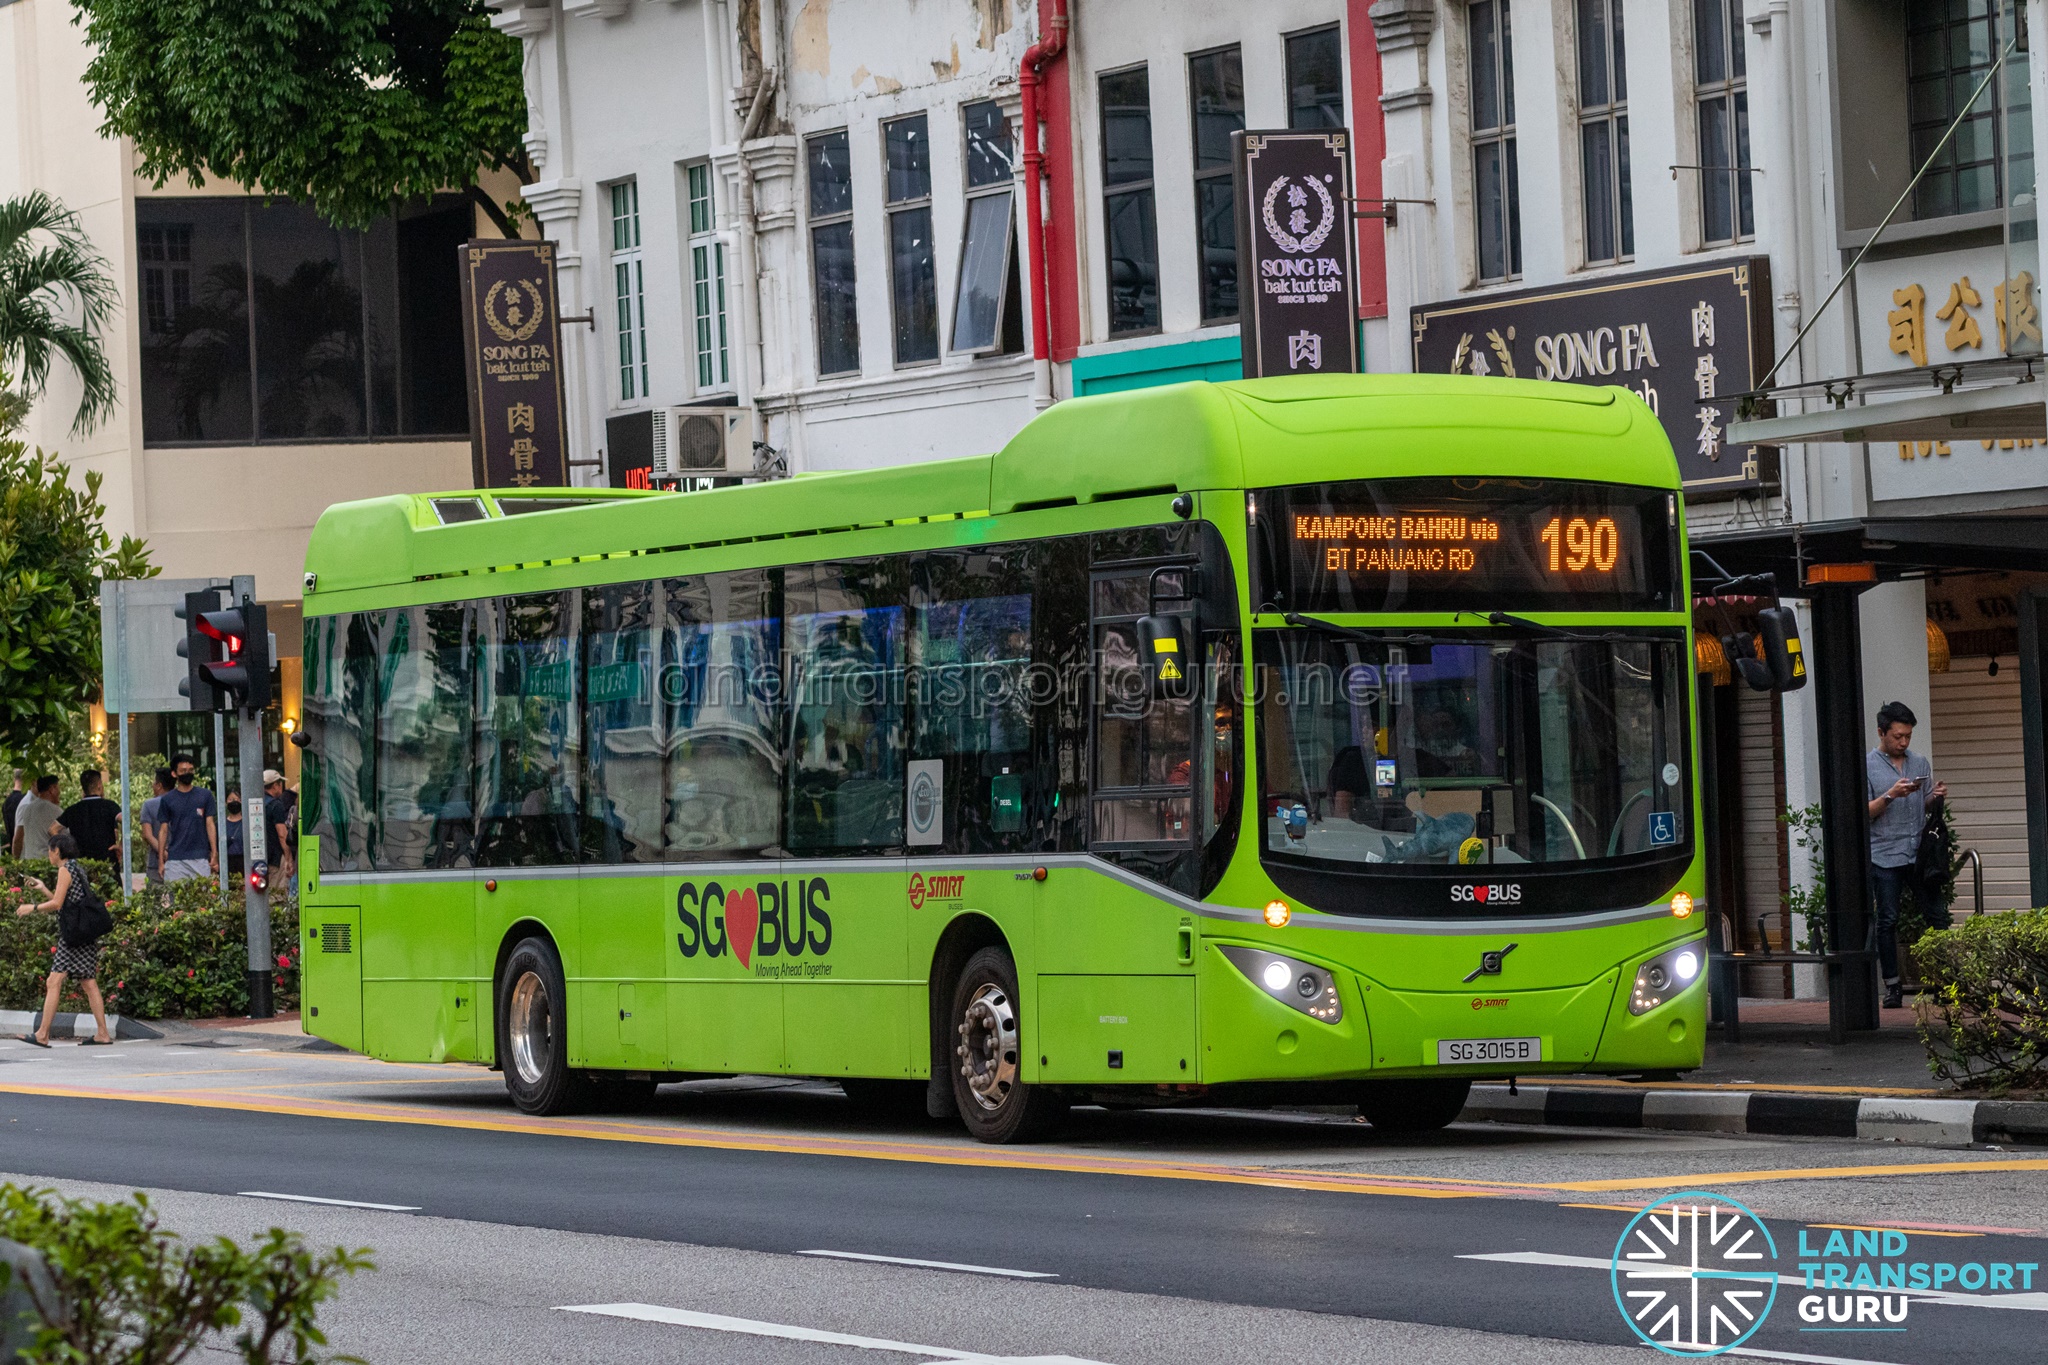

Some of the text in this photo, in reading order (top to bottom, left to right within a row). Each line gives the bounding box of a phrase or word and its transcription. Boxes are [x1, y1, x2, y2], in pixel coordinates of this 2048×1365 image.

[1261, 257, 1343, 277] SONG FA
[1263, 277, 1342, 294] bak kut teh
[1277, 294, 1305, 304] SINCE
[483, 344, 551, 360] SONG FA
[1288, 329, 1322, 370] 肉
[1535, 327, 1617, 381] SONG
[1619, 322, 1660, 372] FA
[486, 359, 551, 375] bak kut teh
[1296, 516, 1499, 540] KAMPONG BAHRU via
[1541, 517, 1618, 572] 190
[1327, 548, 1475, 571] BT PANJANG RD
[926, 875, 965, 898] SMRT
[1450, 883, 1522, 902] SG BUS
[677, 877, 832, 958] SG BUS
[755, 961, 832, 979] Moving Ahead Together
[1484, 998, 1510, 1007] SMRT
[1449, 1041, 1530, 1060] SG3015B
